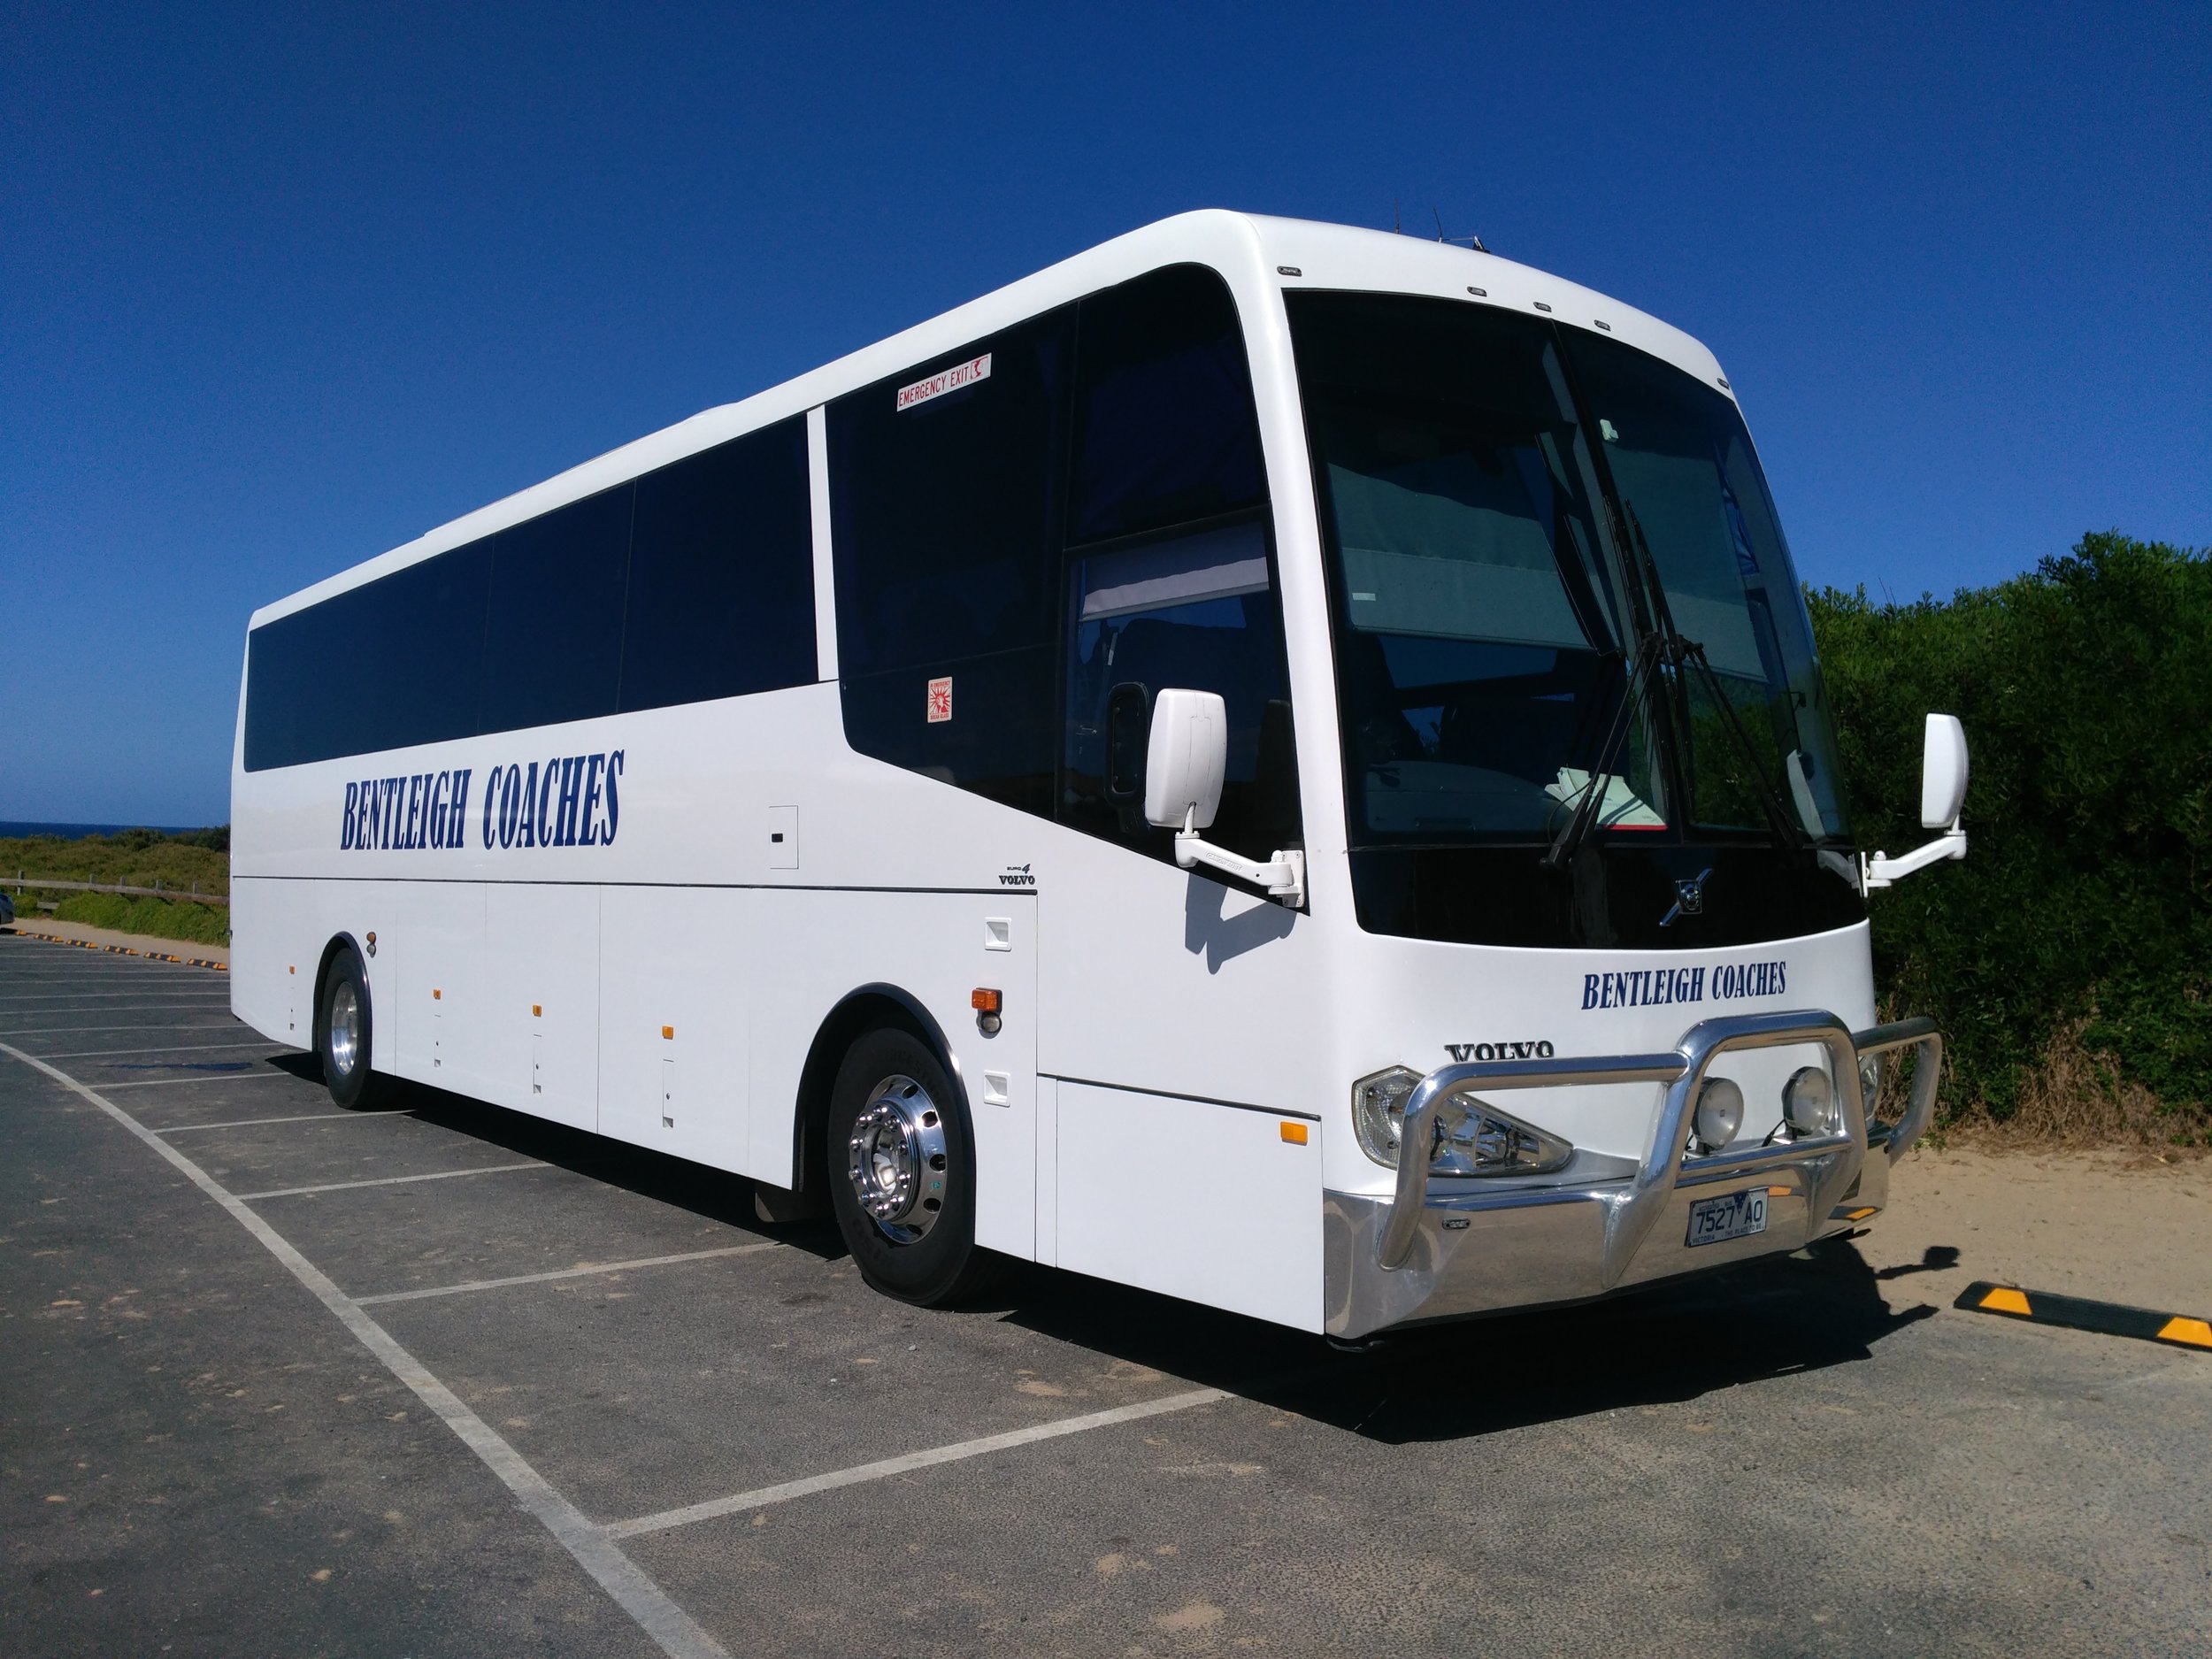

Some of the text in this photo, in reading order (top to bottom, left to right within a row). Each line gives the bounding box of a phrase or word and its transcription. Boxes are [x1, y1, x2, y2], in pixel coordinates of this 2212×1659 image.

[898, 366, 969, 407] EMERGENCY EXIT
[340, 749, 625, 850] BENTLEIGH COACHES
[998, 875, 1035, 885] VOLVO
[1581, 961, 1786, 1010] BENTLEIGH COACHES
[1444, 1040, 1555, 1063] VOLVO
[1696, 1205, 1735, 1234] 7527
[1693, 1234, 1715, 1243] VICTORIA
